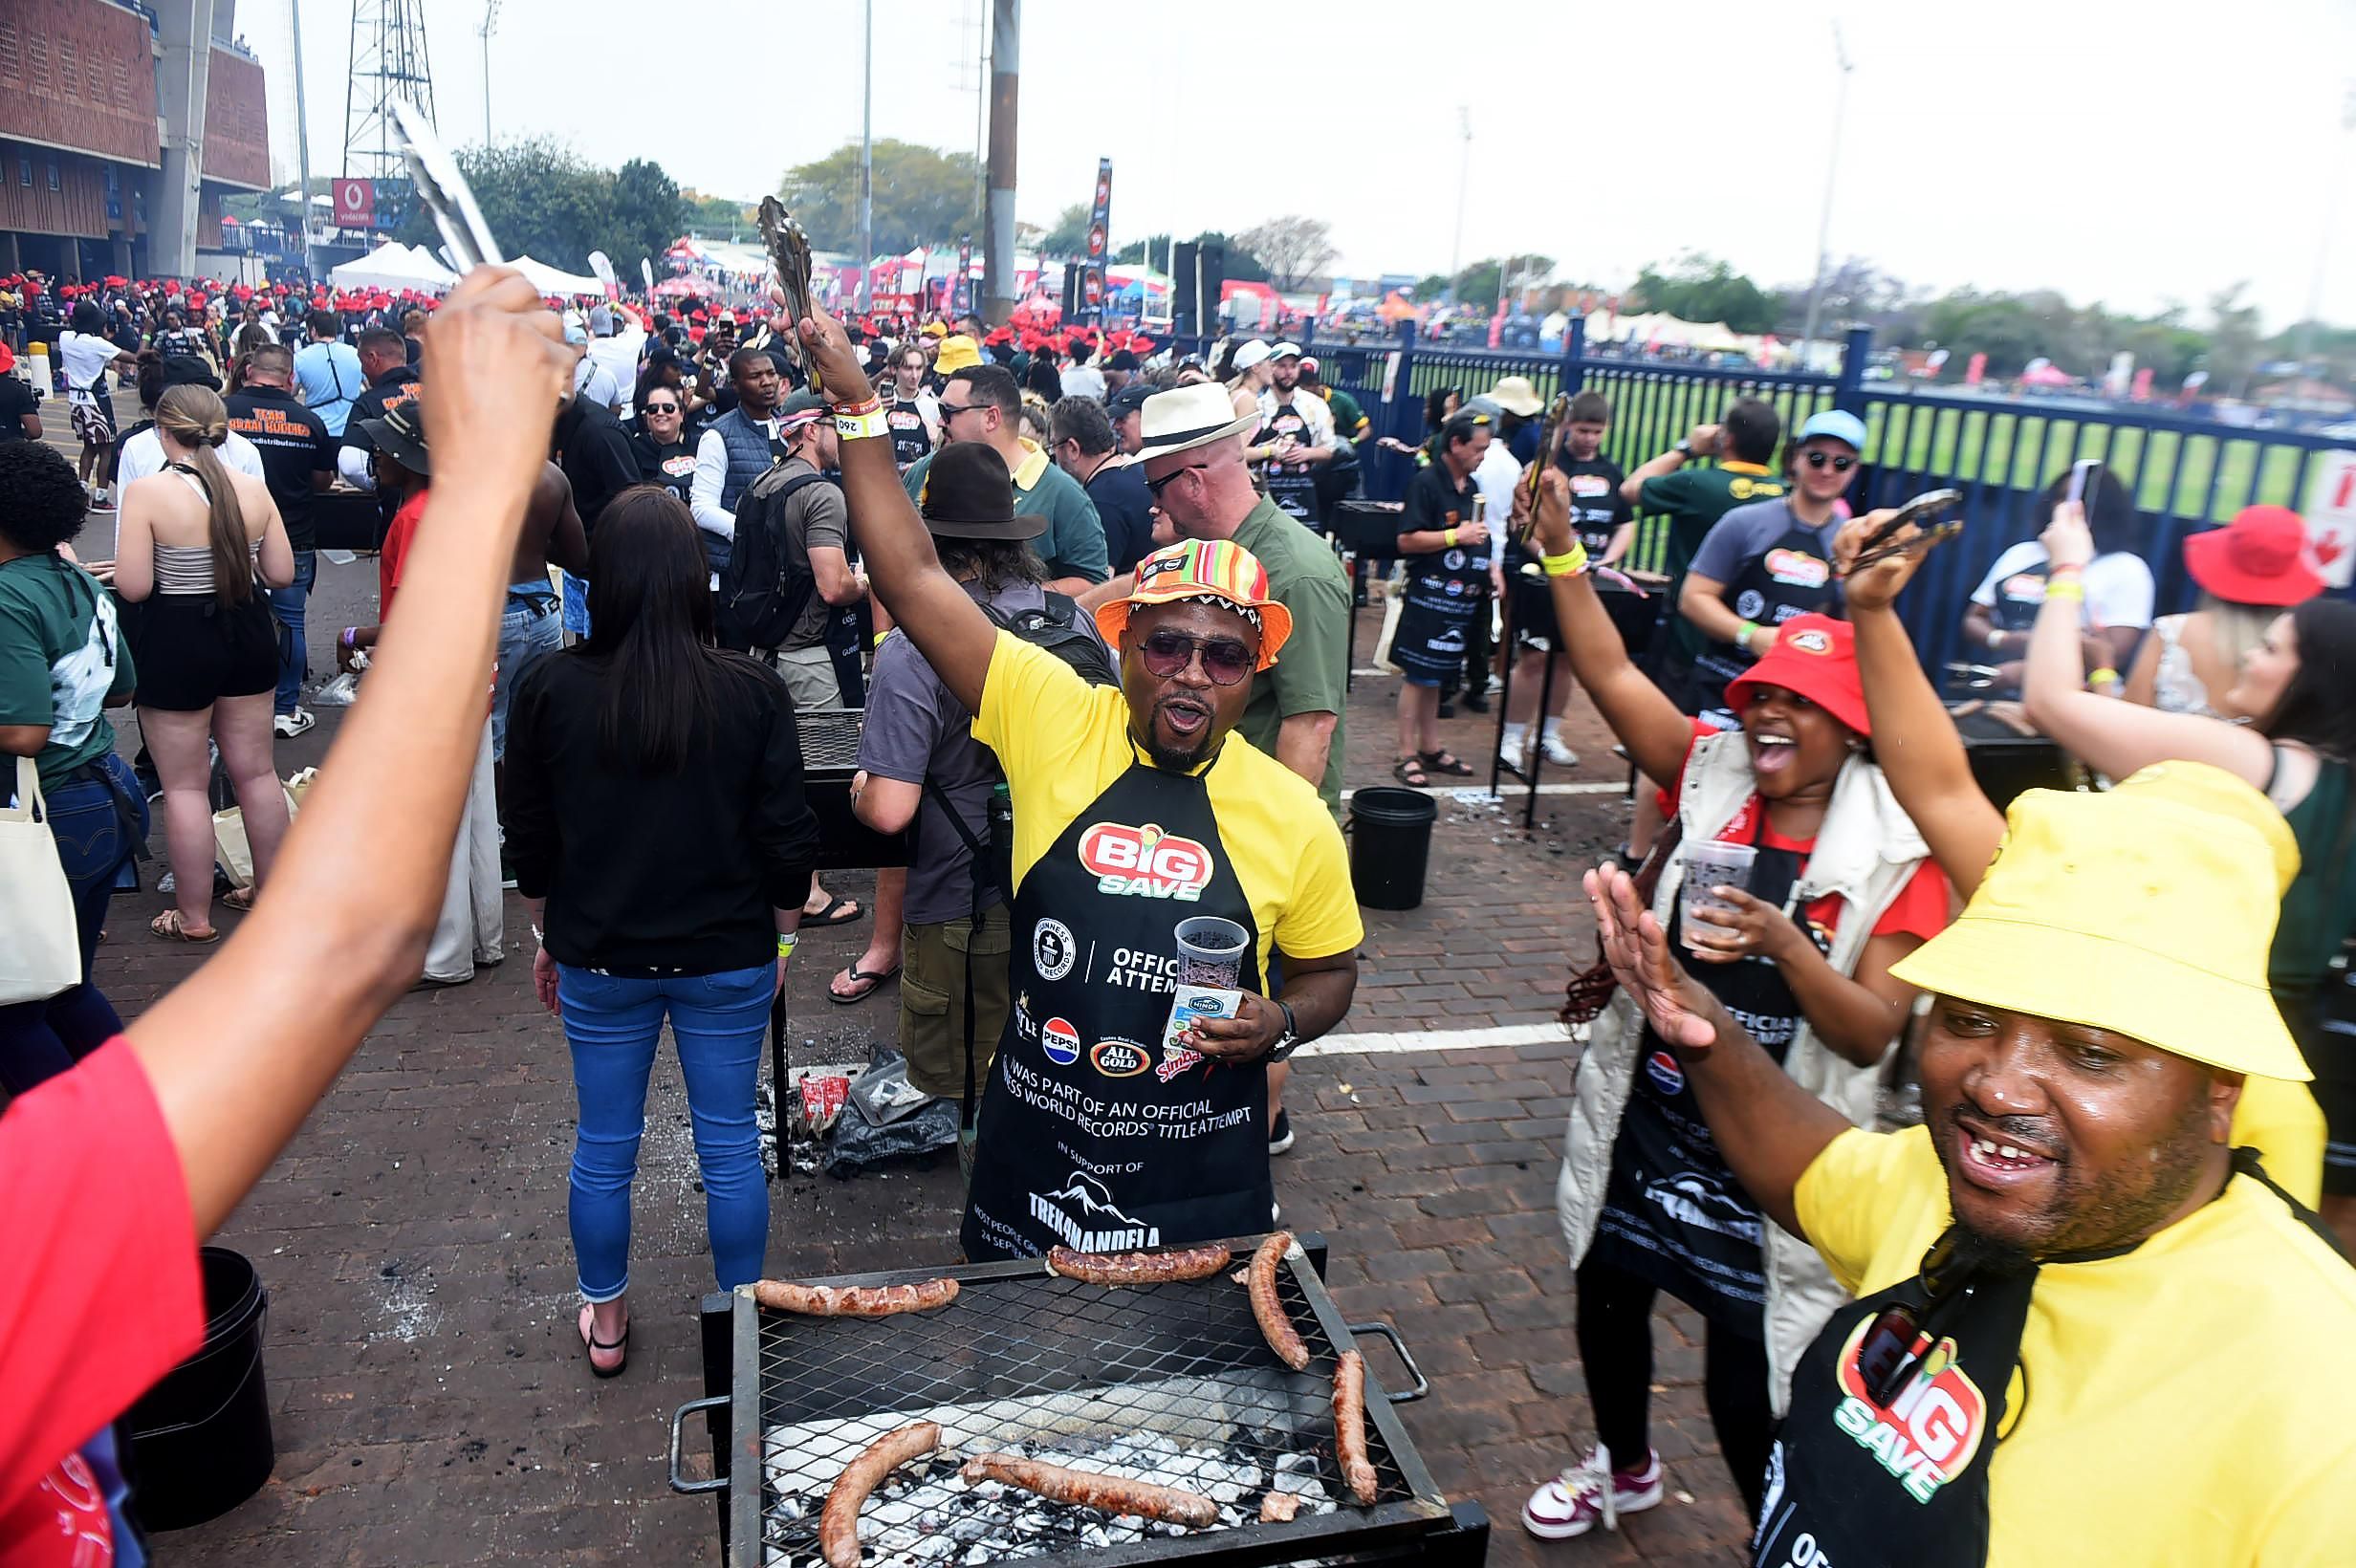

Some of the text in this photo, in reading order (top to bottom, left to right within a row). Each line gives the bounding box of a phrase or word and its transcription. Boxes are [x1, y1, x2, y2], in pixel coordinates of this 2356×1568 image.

[252, 407, 287, 423] TEAM
[839, 420, 857, 431] 260
[1095, 833, 1199, 882] BIG
[1099, 874, 1203, 902] SAVE
[1044, 950, 1072, 976] RECORDS
[1113, 947, 1178, 976] OFFIC
[1106, 967, 1177, 994] ATTEM
[1044, 1031, 1078, 1052] PEPSI
[1105, 1046, 1134, 1059] ALL
[1100, 1056, 1138, 1069] GOLD
[1155, 1051, 1202, 1083] Simba
[1014, 1061, 1038, 1088] WAS
[1042, 1077, 1082, 1105] PART
[1083, 1097, 1106, 1116] OF
[1108, 1101, 1137, 1118] AN
[1142, 1100, 1213, 1122] OFFICIAL
[1025, 1088, 1077, 1121] WORLD
[1158, 1122, 1197, 1140] TITLE
[1197, 1106, 1252, 1135] ATTEMPT
[1058, 1141, 1145, 1175] IN SUPPORT OF
[974, 1203, 991, 1226] MOST
[981, 1229, 992, 1243] 24
[1835, 1396, 1947, 1504] SAVE
